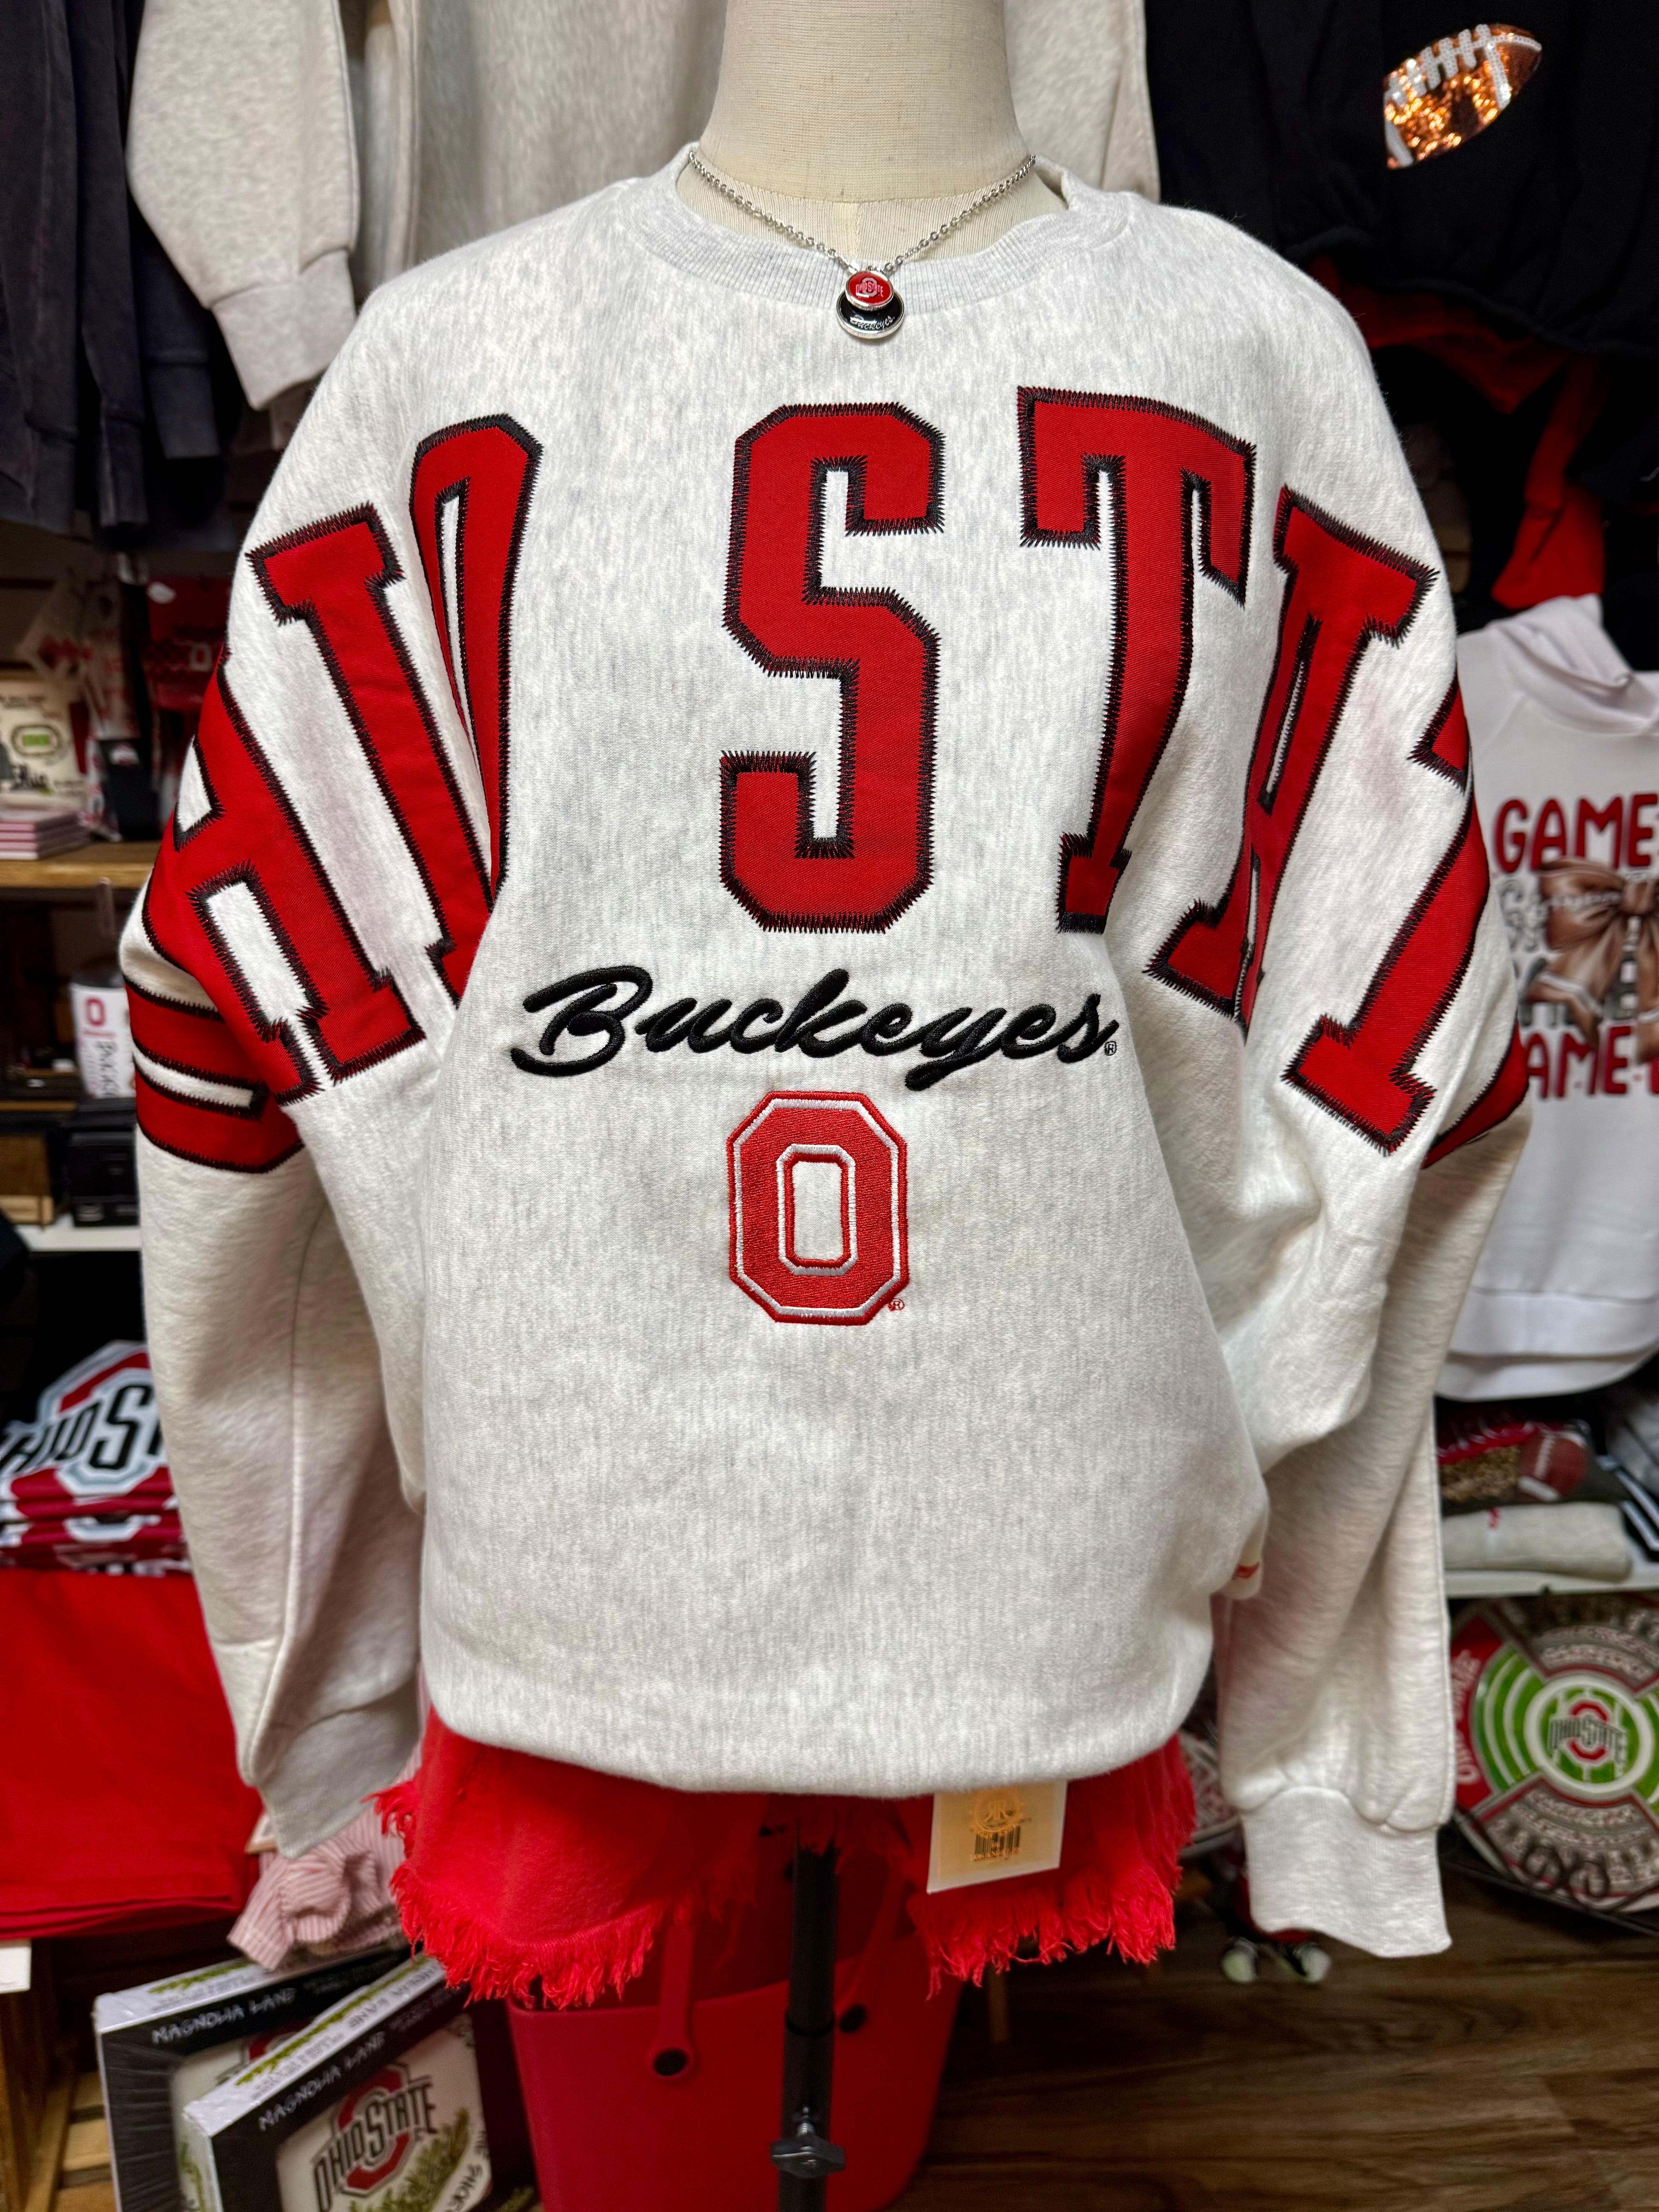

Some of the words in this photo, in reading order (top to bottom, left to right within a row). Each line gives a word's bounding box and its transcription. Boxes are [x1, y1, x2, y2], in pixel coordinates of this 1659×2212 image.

[510, 965, 1120, 1092] Buckeyes
[1525, 1024, 1630, 1100] AME
[726, 1090, 910, 1326] O
[314, 2118, 366, 2212] OHIO
[365, 2080, 438, 2159] STATE
